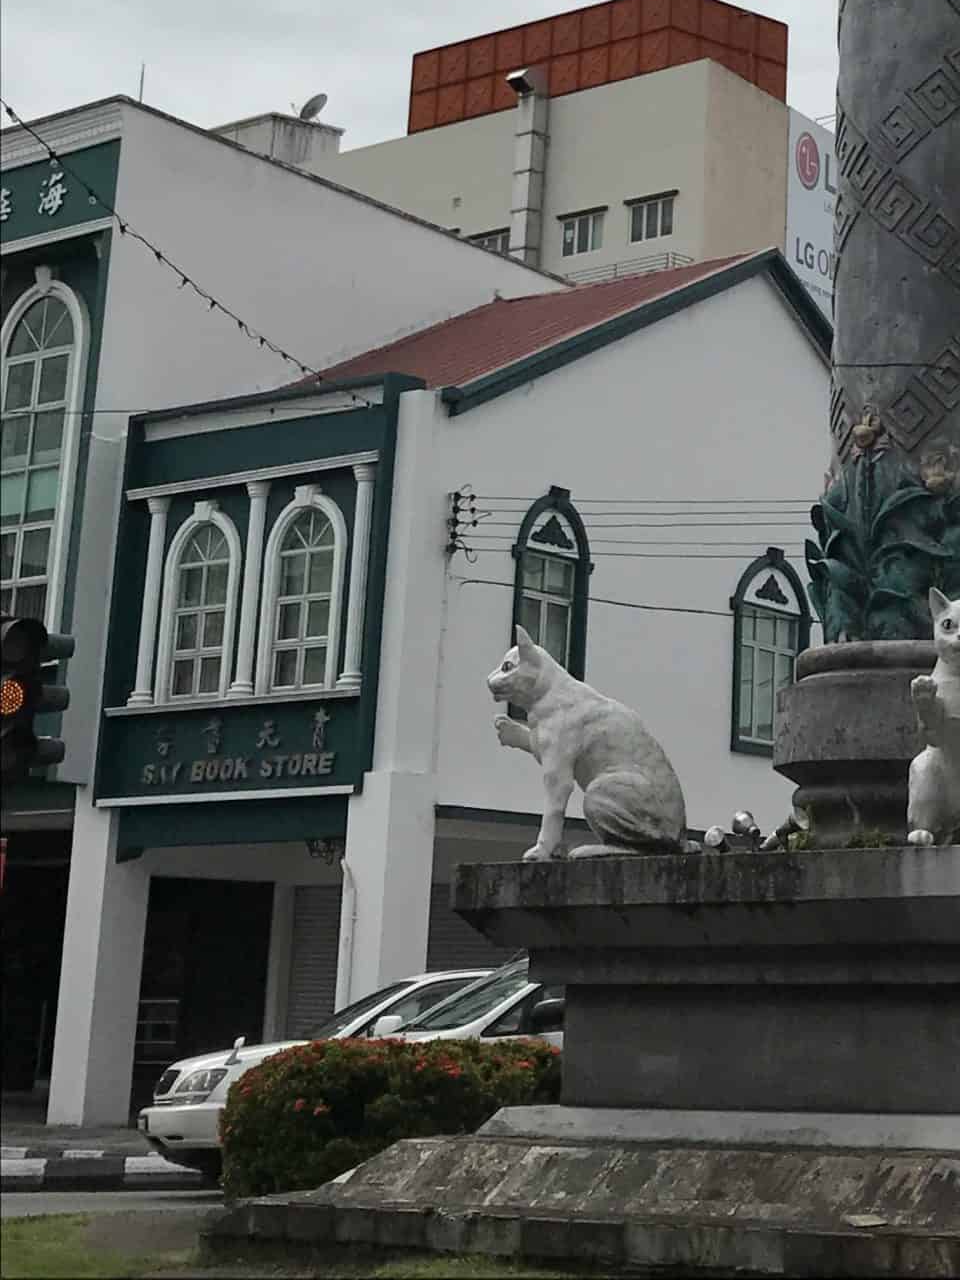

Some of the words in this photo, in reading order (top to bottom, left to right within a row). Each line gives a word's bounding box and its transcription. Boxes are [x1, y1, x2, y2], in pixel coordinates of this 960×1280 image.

[795, 236, 815, 270] LG
[190, 757, 248, 783] BOOK
[259, 752, 335, 778] STORE
